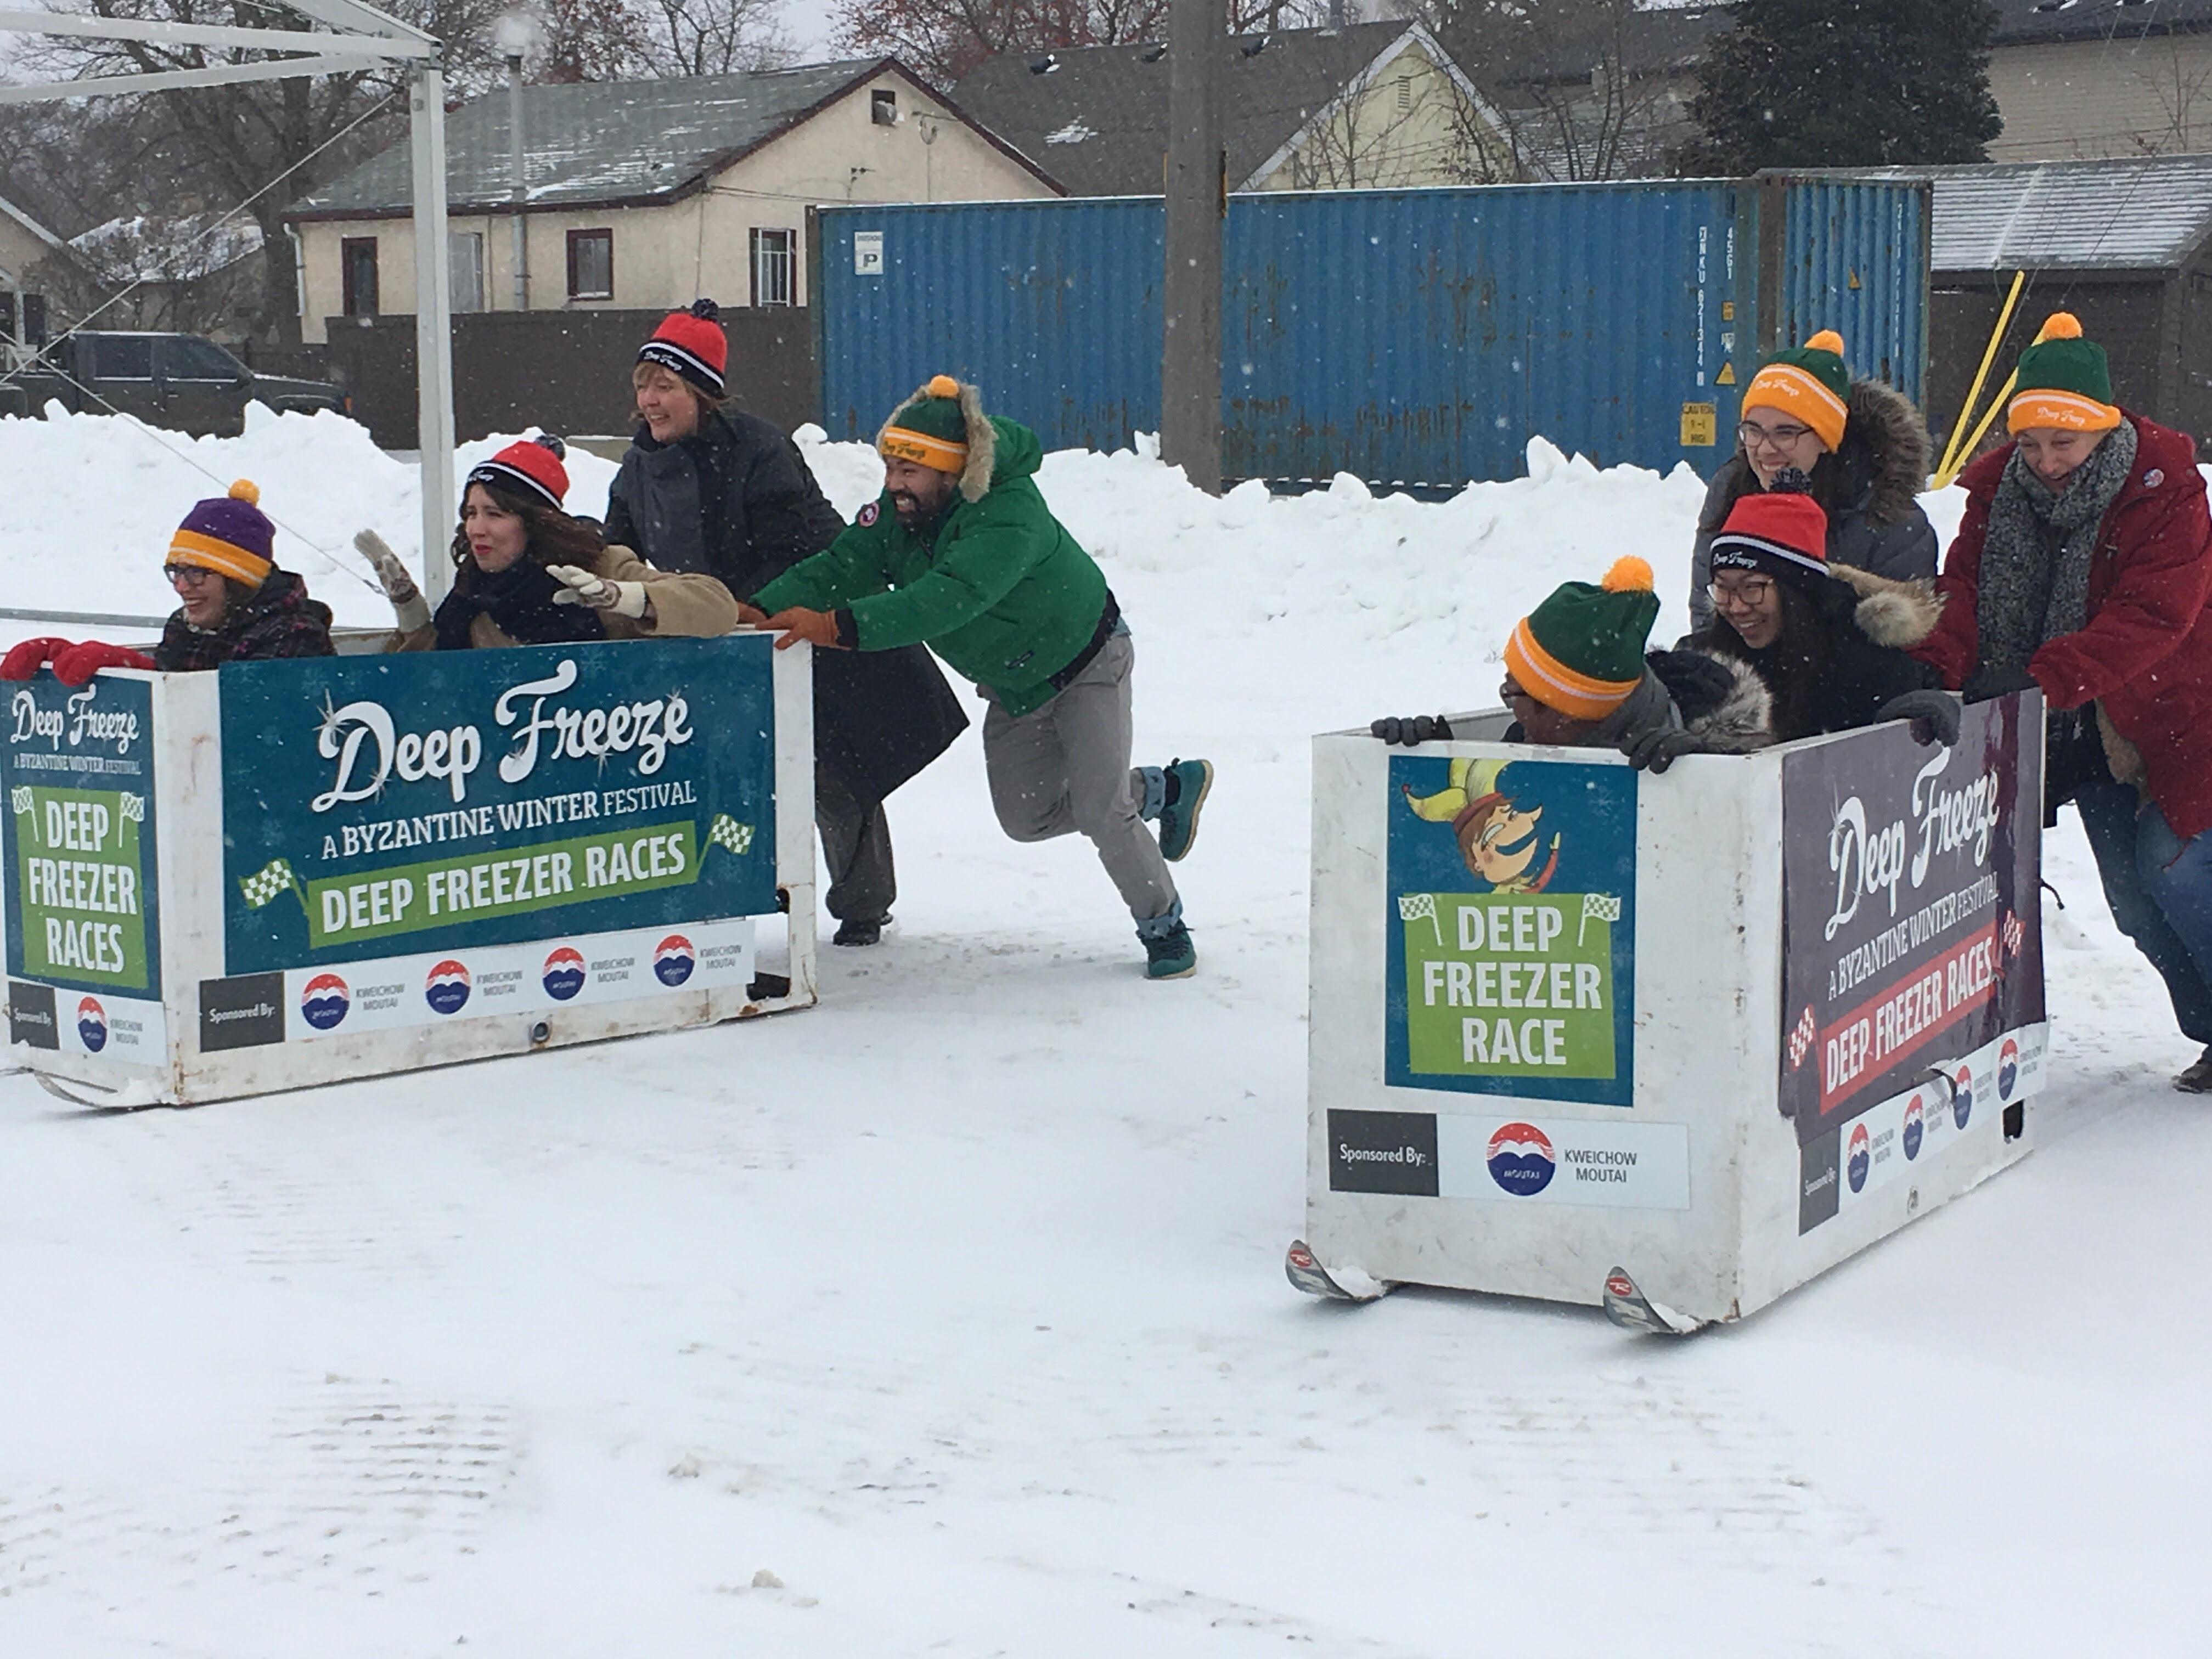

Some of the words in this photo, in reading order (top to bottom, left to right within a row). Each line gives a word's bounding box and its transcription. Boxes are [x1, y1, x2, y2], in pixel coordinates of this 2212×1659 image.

[10, 690, 64, 752] Deep
[67, 683, 139, 754] Freeze
[312, 701, 481, 812] Deep
[495, 659, 693, 783] Freeze
[46, 801, 109, 851] DEEP
[321, 836, 338, 860] A
[342, 810, 494, 857] BYZANTINE
[496, 791, 600, 831] WINTER
[603, 780, 697, 816] FESTIVAL
[1825, 797, 1905, 941] Deep
[1911, 746, 2000, 889] Freeze
[28, 857, 137, 915] FREEZER
[322, 878, 413, 933] DEEP
[426, 851, 574, 916] FREEZER
[585, 833, 686, 888] RACES
[46, 917, 125, 973] RACES
[1457, 906, 1563, 952] DEEP
[1828, 970, 1837, 1001] A
[1838, 919, 1909, 995] BYZANTINE
[1909, 891, 1956, 949] WINTER
[1957, 871, 1999, 921] FESTIVAL
[363, 997, 398, 1011] MOUTAI
[1423, 961, 1602, 1009] FREEZER
[209, 1003, 258, 1024] Sponsored
[1826, 1017, 1870, 1095] DEEP
[1876, 969, 1943, 1062] FREEZER
[1947, 935, 1994, 1013] RACES
[1462, 1017, 1567, 1065] RACE
[1339, 1143, 1404, 1164] Sponsored
[1406, 1146, 1426, 1167] By:
[1564, 1149, 1637, 1166] KWEICHOW
[1575, 1167, 1627, 1183] MOUTAI
